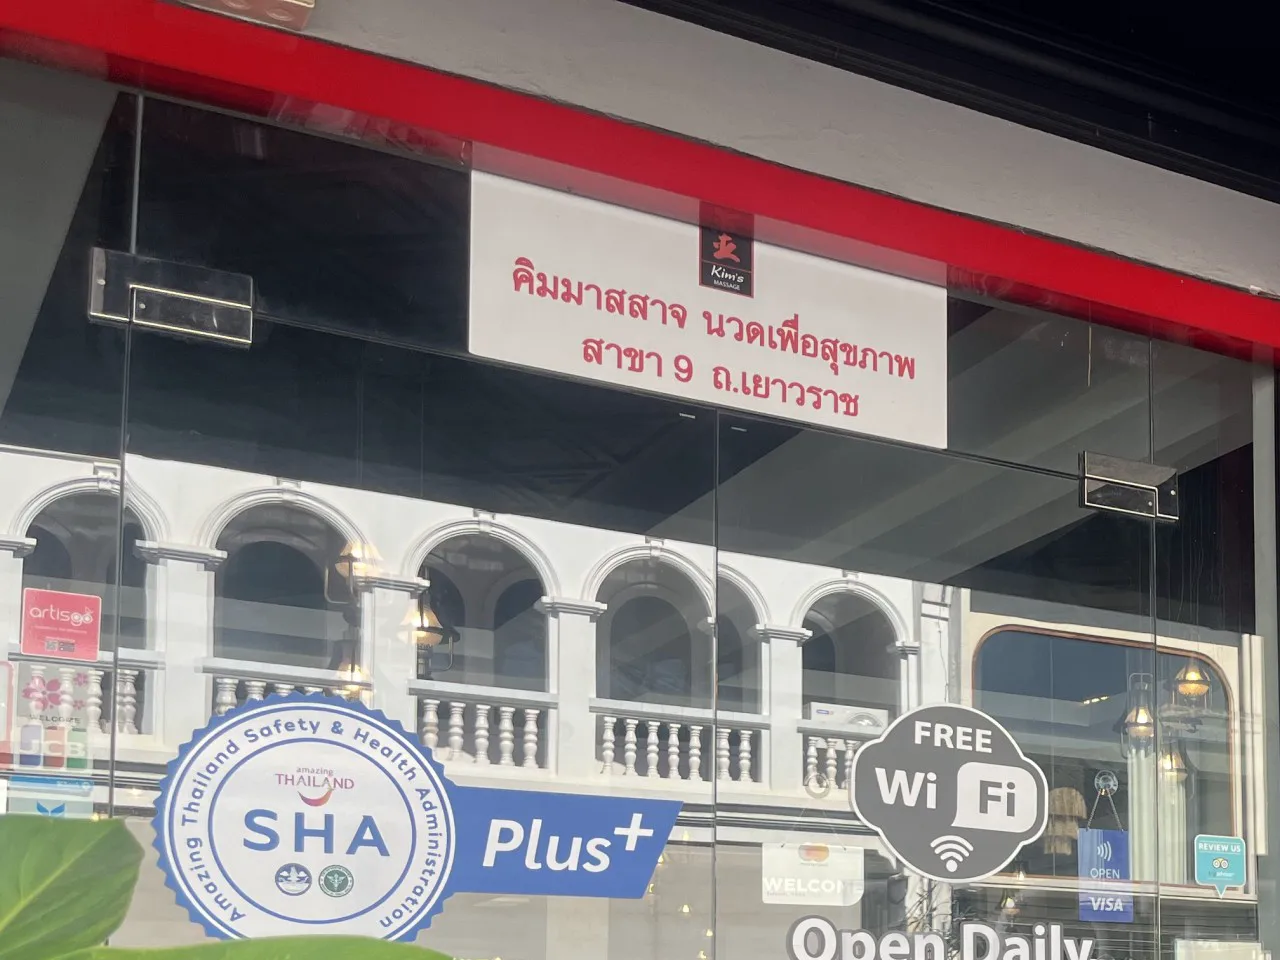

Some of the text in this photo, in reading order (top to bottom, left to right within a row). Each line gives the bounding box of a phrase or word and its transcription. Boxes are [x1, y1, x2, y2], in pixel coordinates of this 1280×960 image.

[711, 265, 744, 283] Kim's
[713, 279, 741, 291] MASSAGE
[512, 256, 916, 380] คิมมาสสาจ นวดเพื่อสุขภาพ
[582, 336, 860, 418] สาขา 9 ถ.เยาวราช
[29, 604, 94, 627] artisgo
[914, 720, 993, 754] FREE
[275, 773, 355, 790] THAILAND
[296, 766, 334, 777] amazing
[875, 766, 1016, 818] Wi Fi
[181, 718, 443, 929] Amazing Thailand Safety & Health Administration
[242, 808, 391, 858] SHA
[1198, 842, 1241, 853] REVIEW US
[1090, 867, 1120, 879] OPEN
[1088, 896, 1125, 912] VISA
